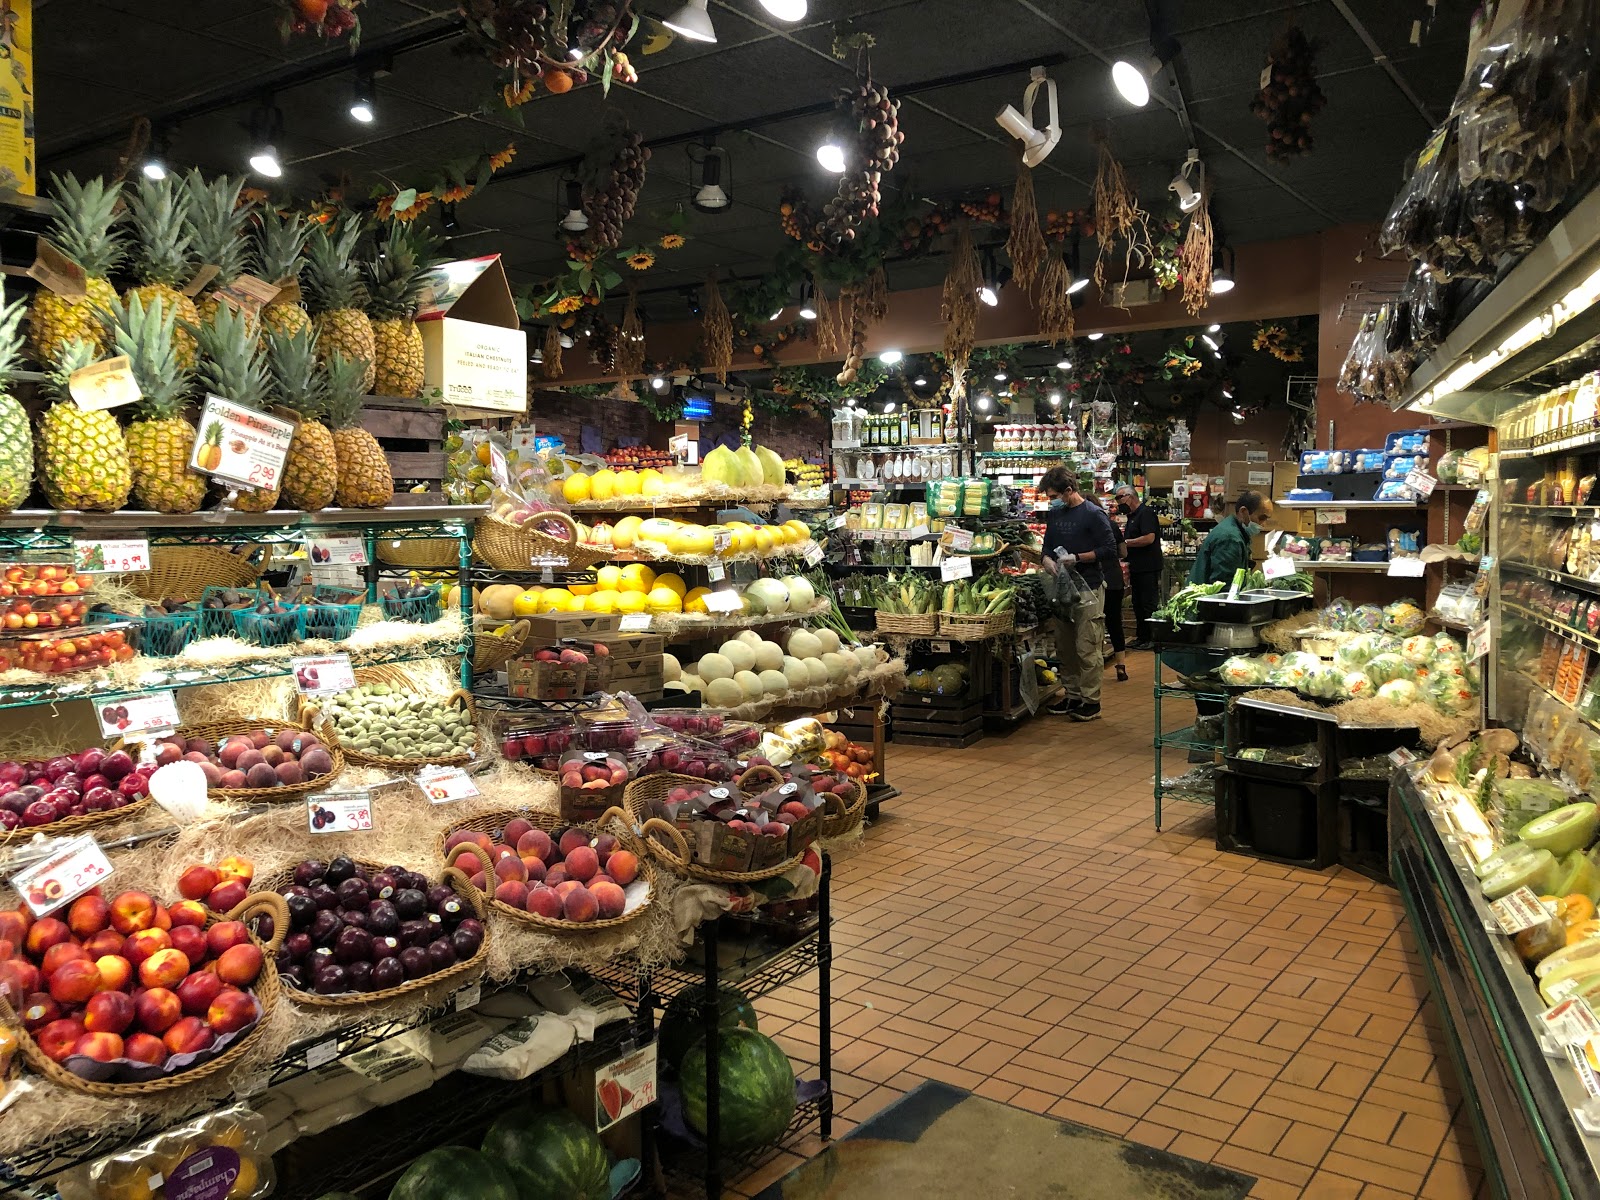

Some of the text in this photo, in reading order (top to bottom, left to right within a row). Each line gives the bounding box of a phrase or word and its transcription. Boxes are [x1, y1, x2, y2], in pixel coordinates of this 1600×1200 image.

[457, 359, 474, 367] PEELED
[465, 351, 512, 364] ITALIAN CHESTNUTS
[207, 402, 291, 439] Golden Pineapple
[230, 428, 258, 442] Pineapple
